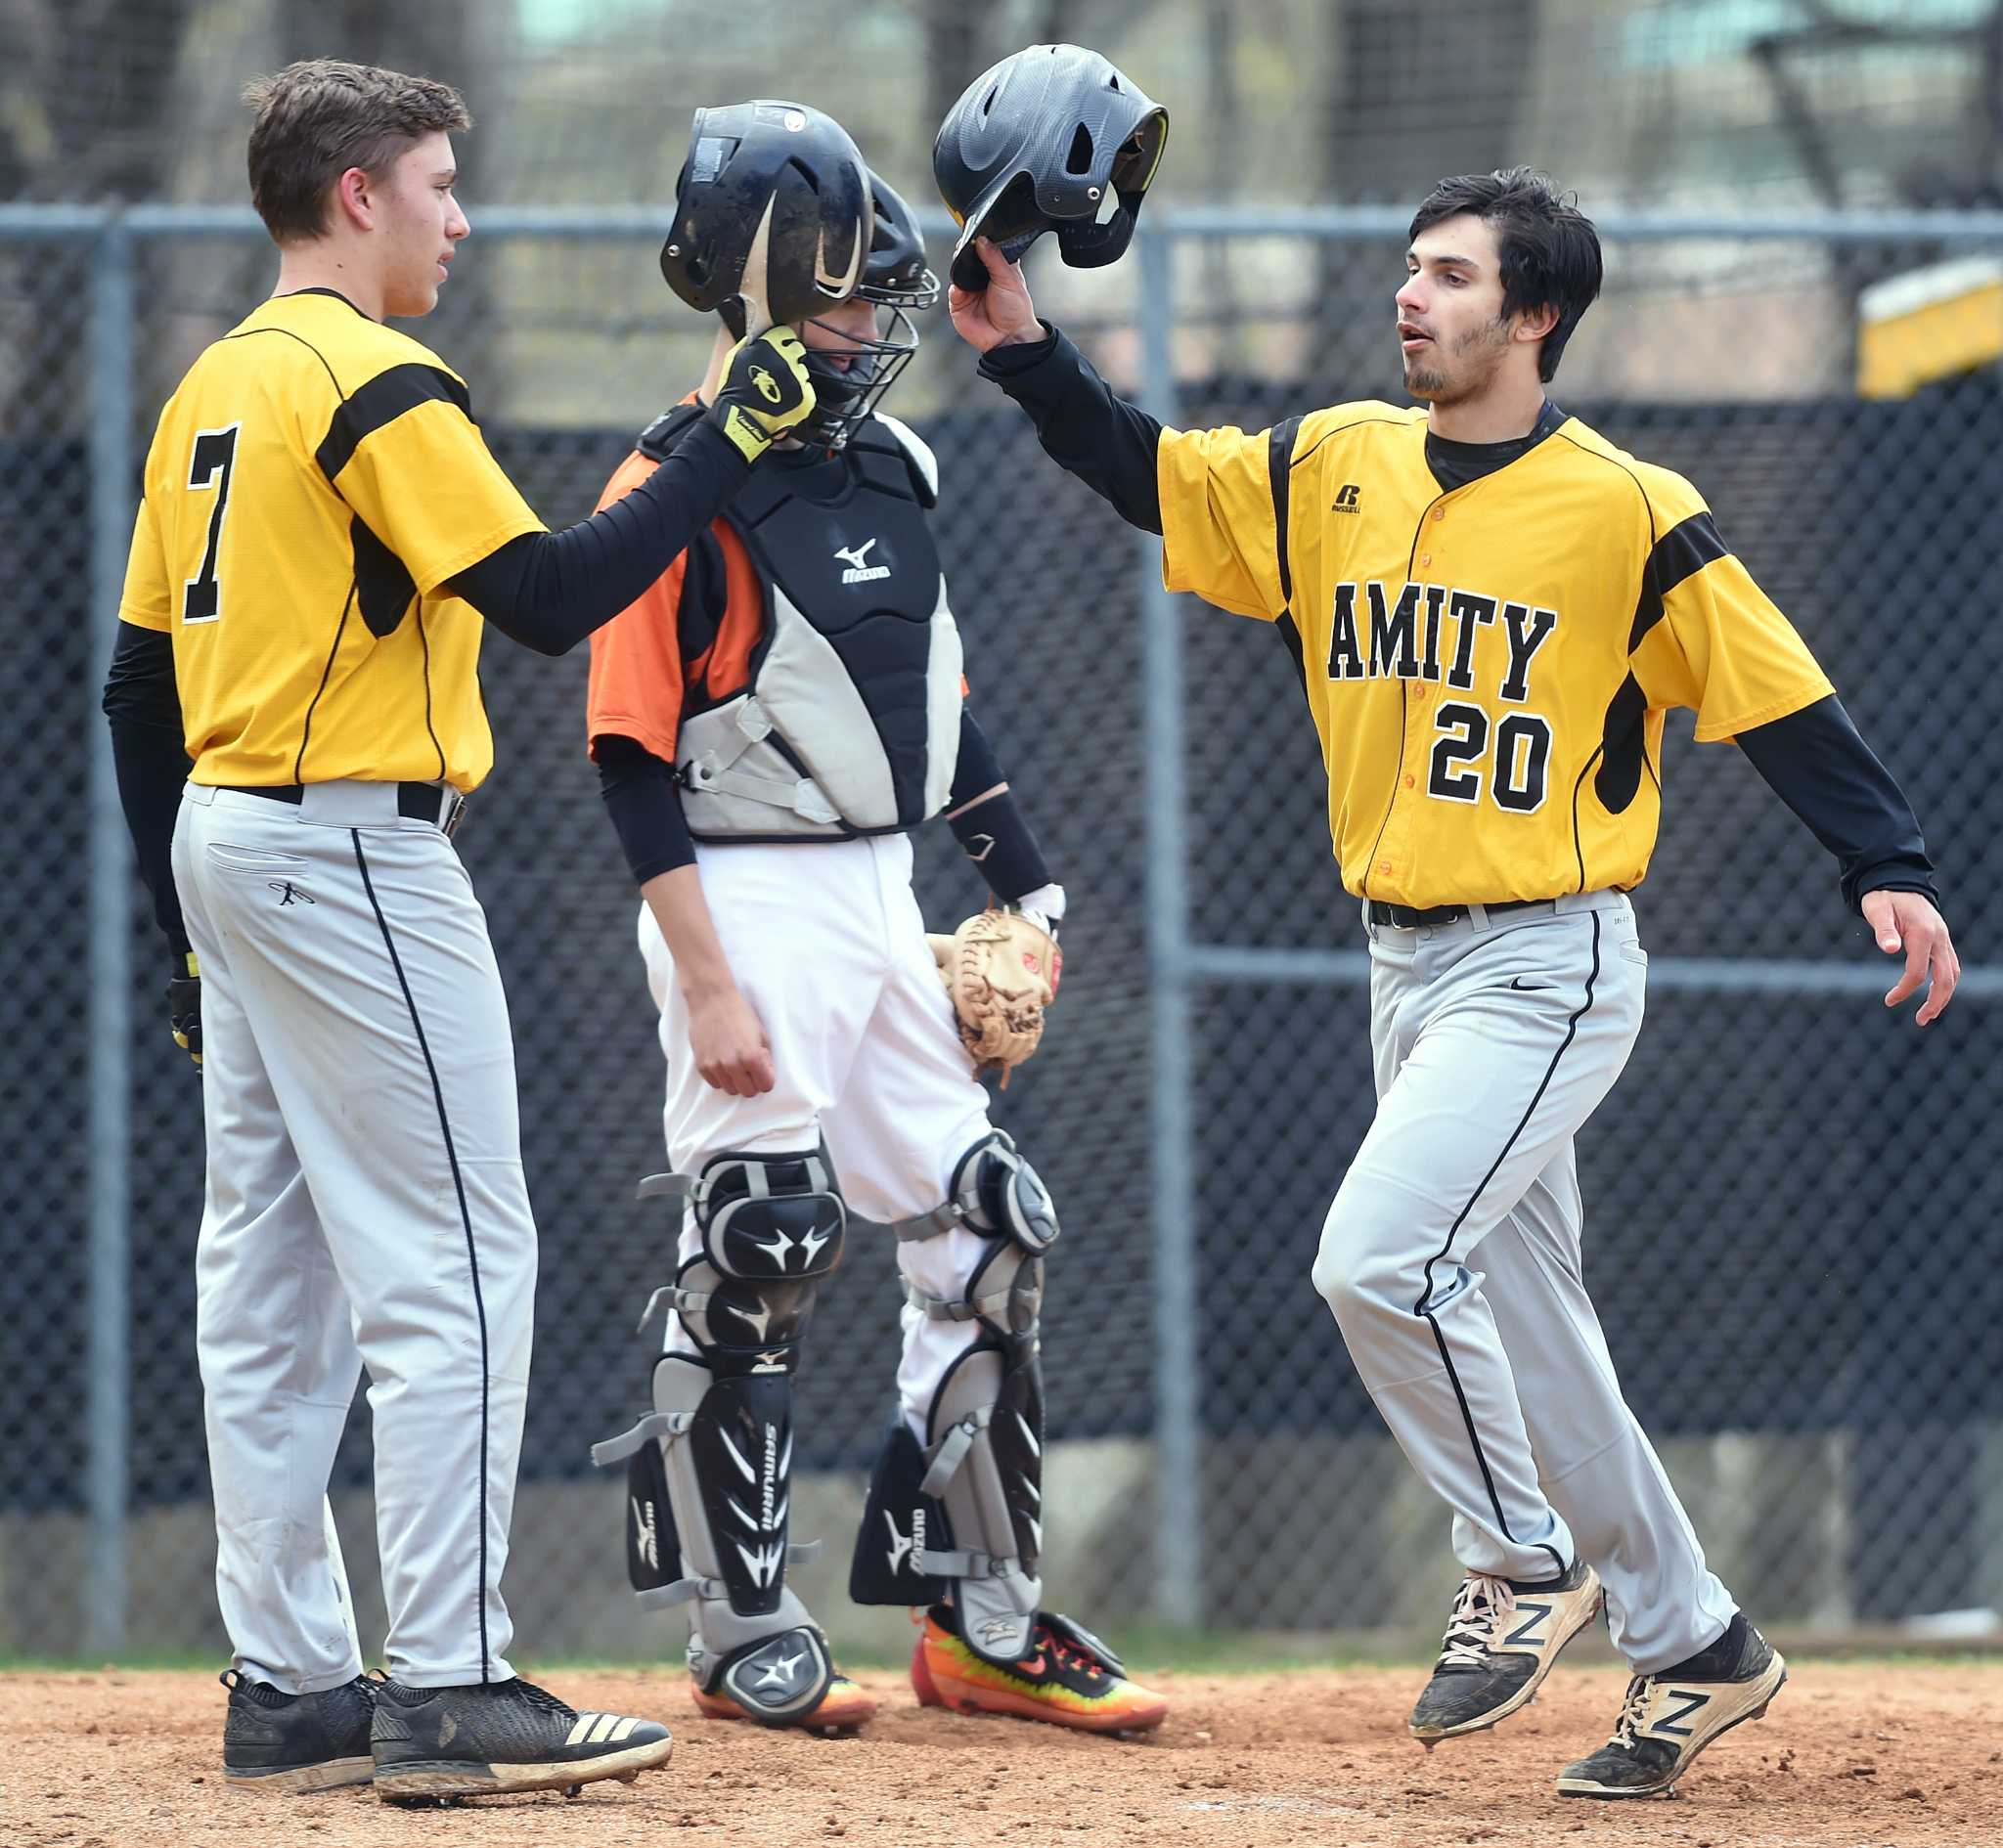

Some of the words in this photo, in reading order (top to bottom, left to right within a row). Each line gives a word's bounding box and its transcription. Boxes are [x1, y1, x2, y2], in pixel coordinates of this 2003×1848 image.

[182, 420, 243, 625] 7
[1326, 579, 1559, 704] AMITY
[1426, 698, 1554, 814] 20
[761, 1422, 778, 1531] SAMURAI
